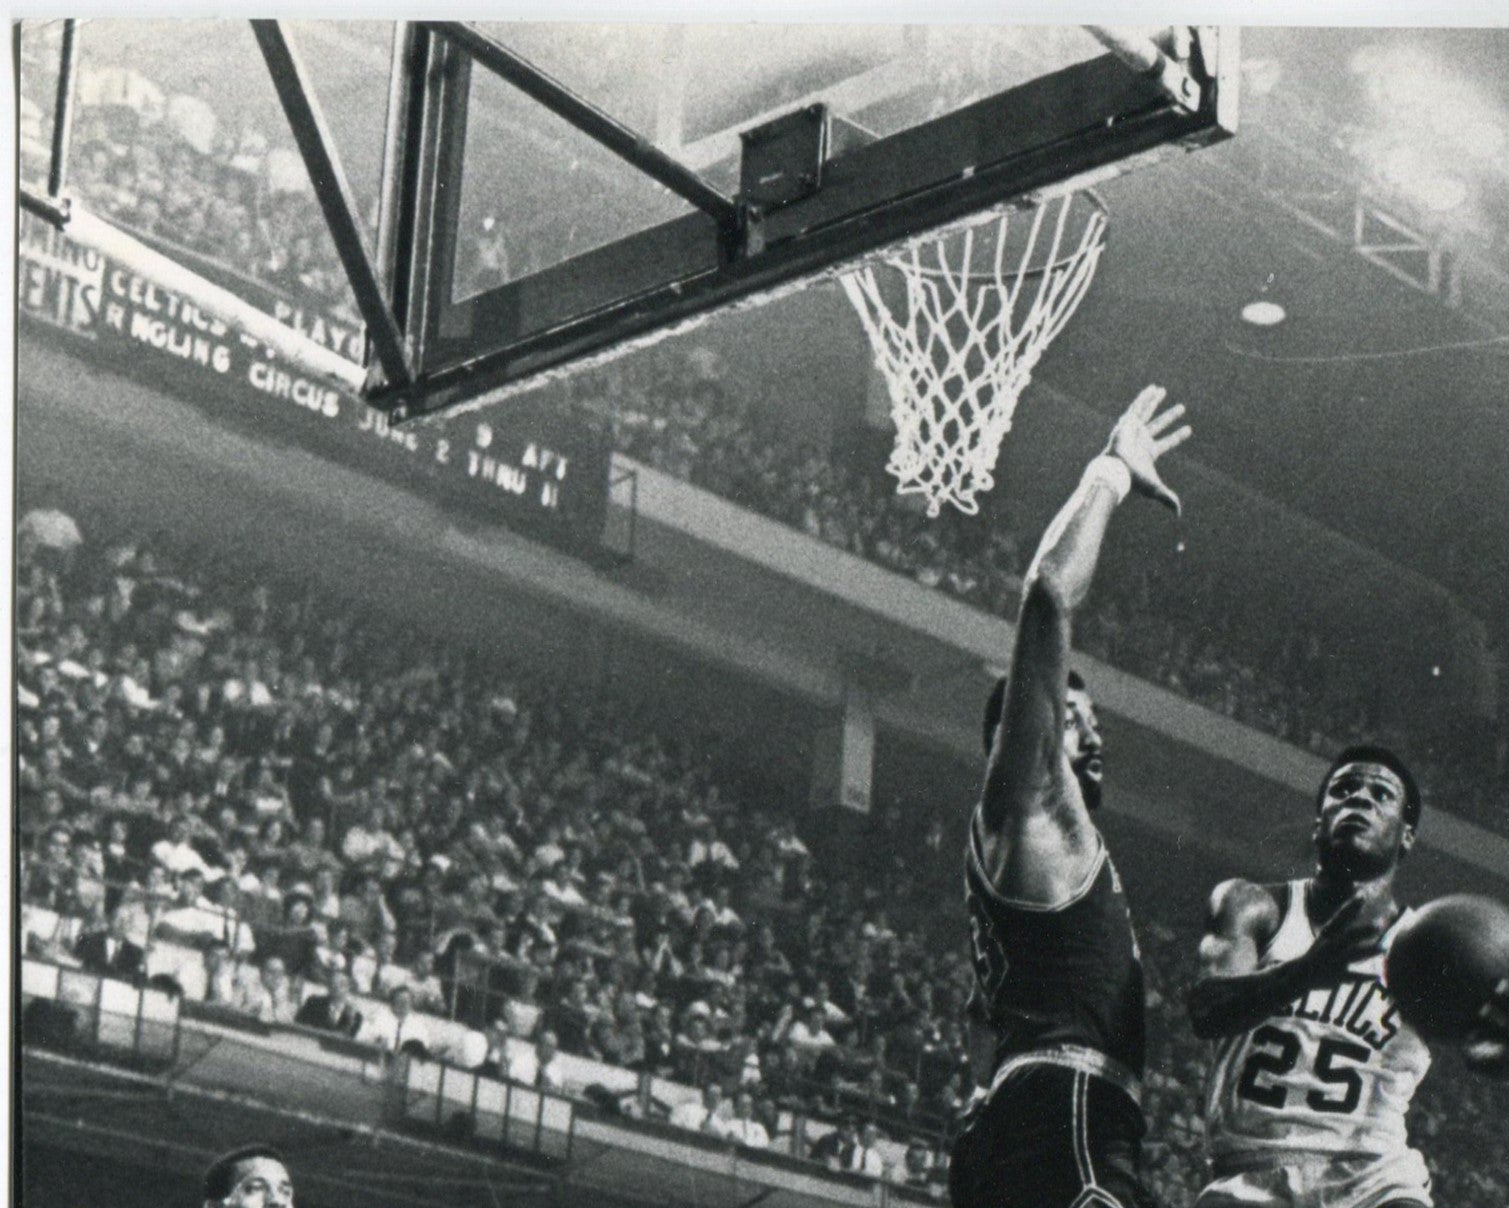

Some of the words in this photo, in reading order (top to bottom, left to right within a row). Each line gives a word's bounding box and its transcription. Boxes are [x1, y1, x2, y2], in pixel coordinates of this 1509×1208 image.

[105, 301, 230, 374] RNGLING
[248, 361, 339, 418] CIRCUS
[1238, 1024, 1372, 1114] 25
